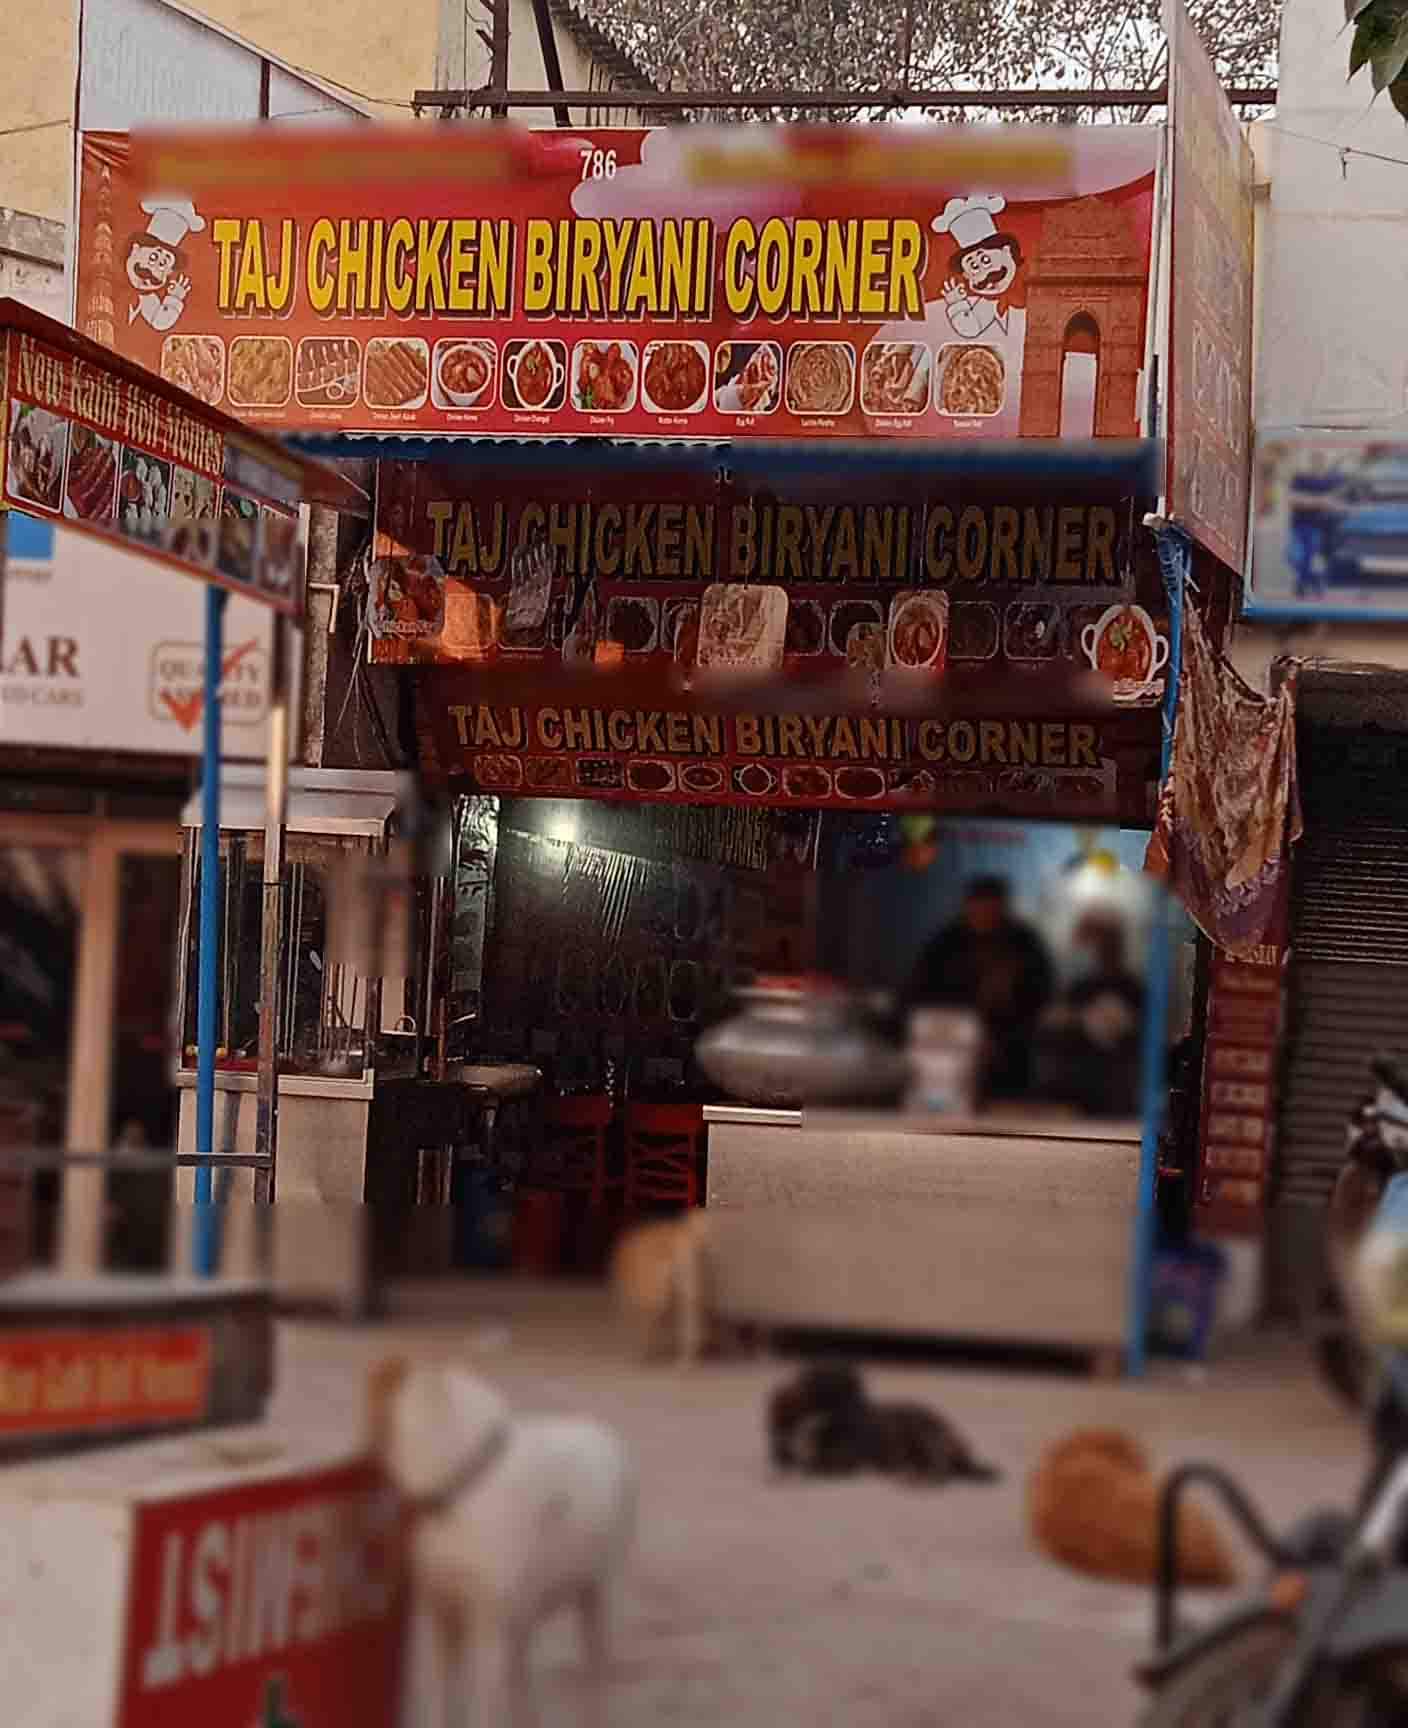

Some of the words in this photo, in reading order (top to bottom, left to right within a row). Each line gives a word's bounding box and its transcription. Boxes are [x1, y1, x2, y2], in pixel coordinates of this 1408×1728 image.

[580, 149, 618, 183] 786
[213, 218, 295, 312] TAJ
[307, 218, 510, 312] CHICKEN
[525, 219, 711, 314] BIRYANI
[725, 218, 922, 315] CORNER
[17, 333, 64, 406] New
[427, 502, 502, 575] TAJ
[519, 503, 713, 576] CHICKEN
[731, 505, 908, 577] BIRYANI
[926, 505, 1117, 578] CORNER
[0, 635, 80, 678] AR
[449, 706, 524, 748] TAJ
[536, 708, 721, 754] CHICKEN
[735, 714, 901, 761] BIRYANI
[919, 719, 1098, 766] CORNER
